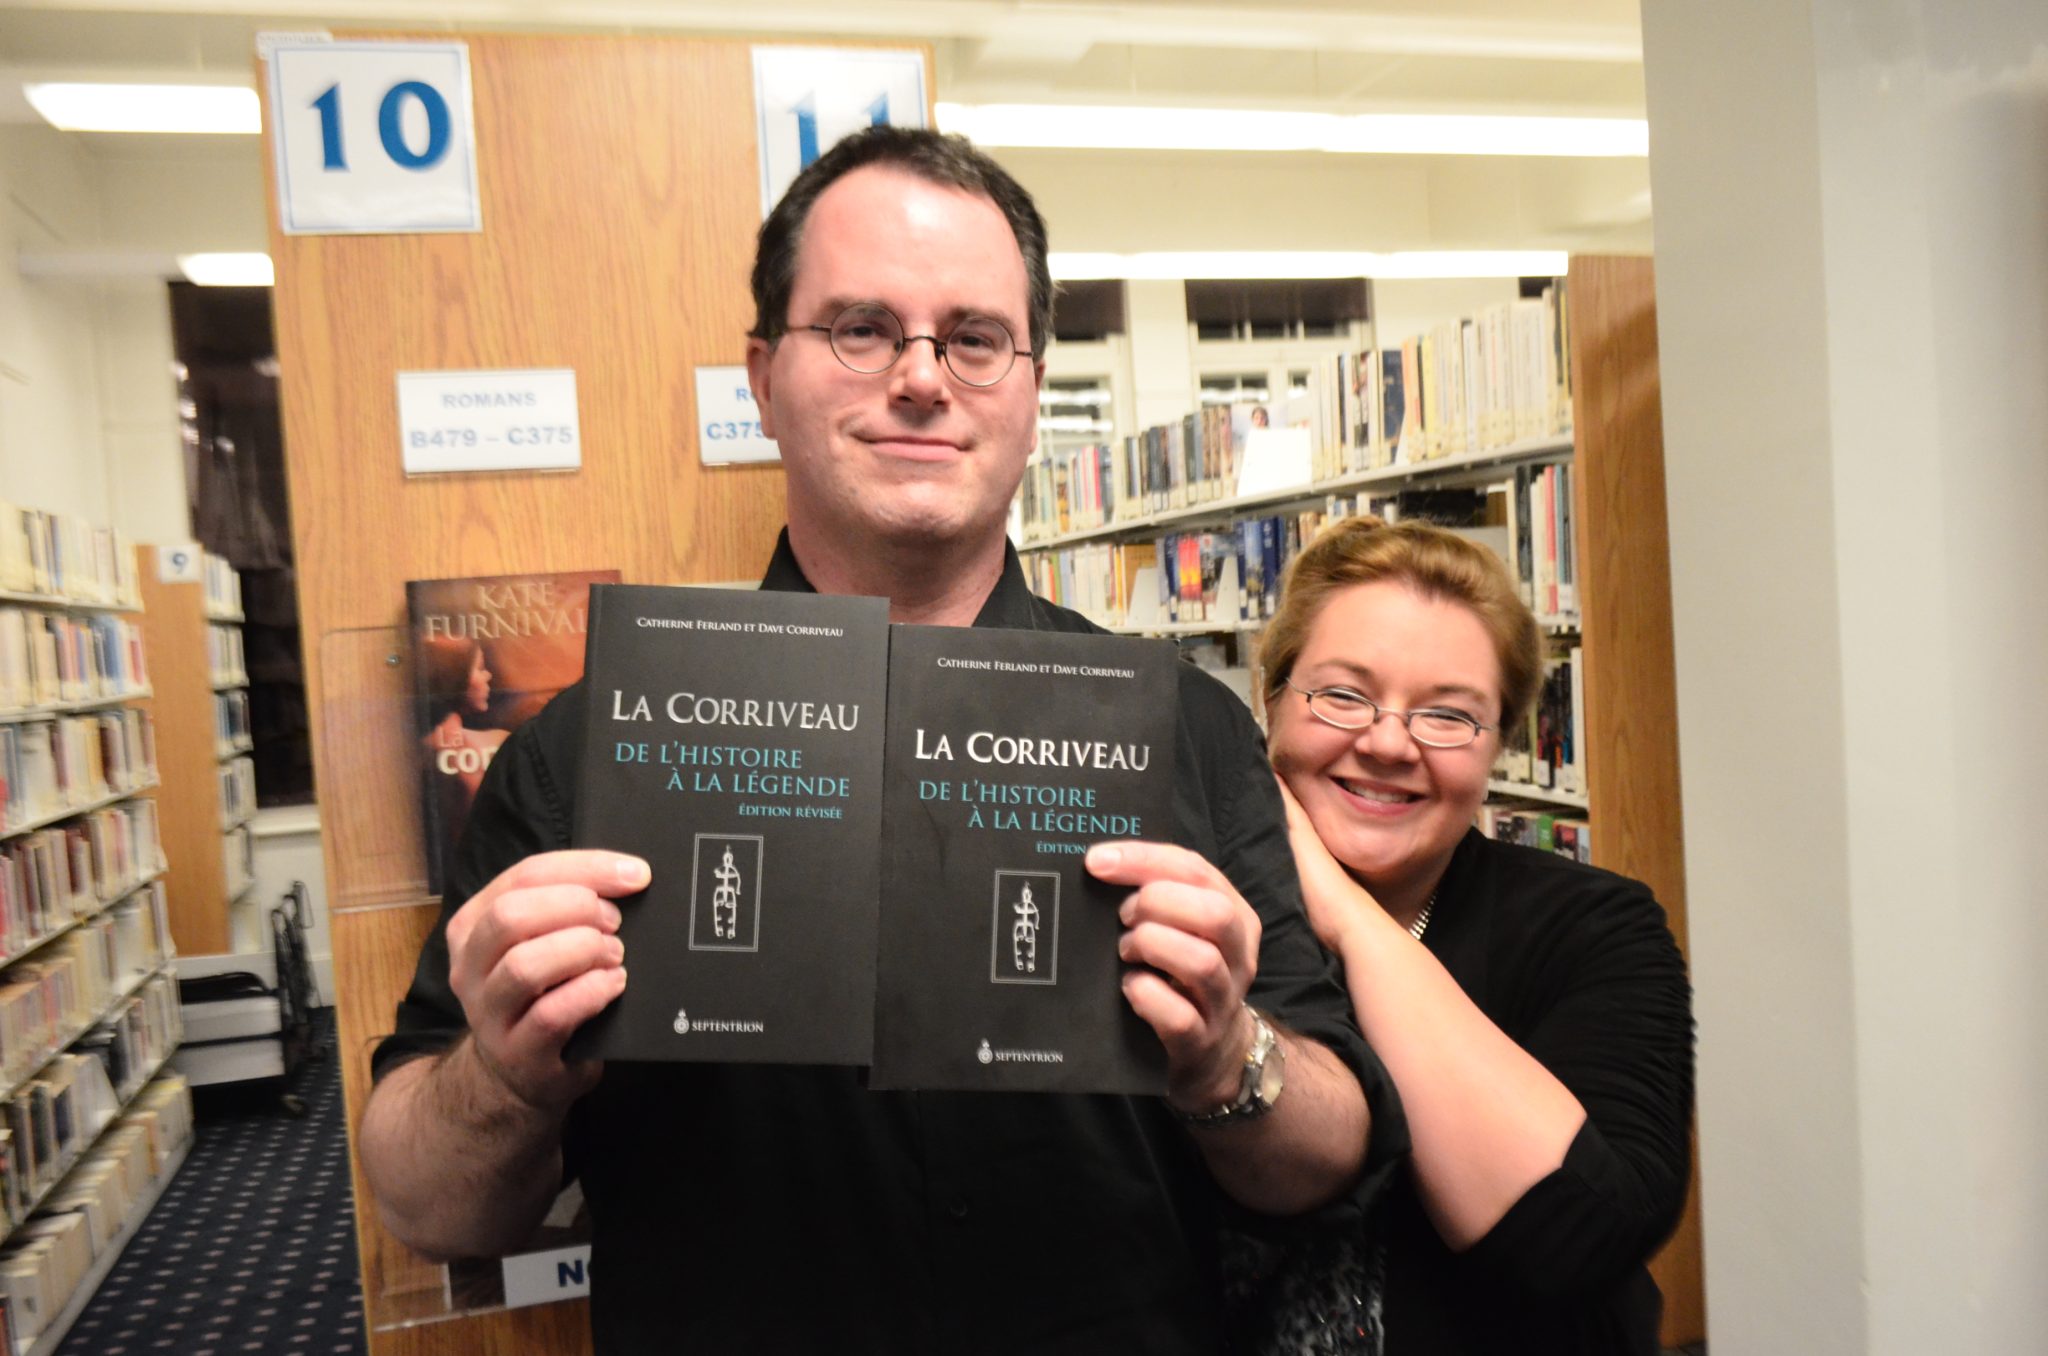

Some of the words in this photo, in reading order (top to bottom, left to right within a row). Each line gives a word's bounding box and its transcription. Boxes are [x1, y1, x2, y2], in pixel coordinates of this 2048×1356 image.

[309, 80, 453, 172] 10
[442, 392, 537, 409] ROMANS
[410, 428, 478, 448] B479
[507, 425, 572, 446] C375
[476, 582, 554, 610] KATE
[744, 623, 757, 633] ET
[1040, 664, 1051, 674] ET
[437, 728, 464, 748] La
[615, 742, 649, 763] DE
[660, 741, 802, 769] L'HISTOIRE
[666, 767, 684, 791] À
[694, 772, 723, 792] LA
[733, 771, 850, 797] LÉGENDE
[919, 780, 950, 801] DE
[961, 779, 1096, 808] L'HISTOIRE
[739, 804, 791, 817] ÉDITION
[796, 805, 843, 820] RÉVISÉE
[968, 804, 984, 829] À
[994, 810, 1021, 831] LA
[1031, 808, 1142, 836] LÉGENDE
[1036, 840, 1086, 854] ÉDITION
[692, 1020, 764, 1033] SEPTENTRION
[995, 1049, 1063, 1063] SEPTENTRION
